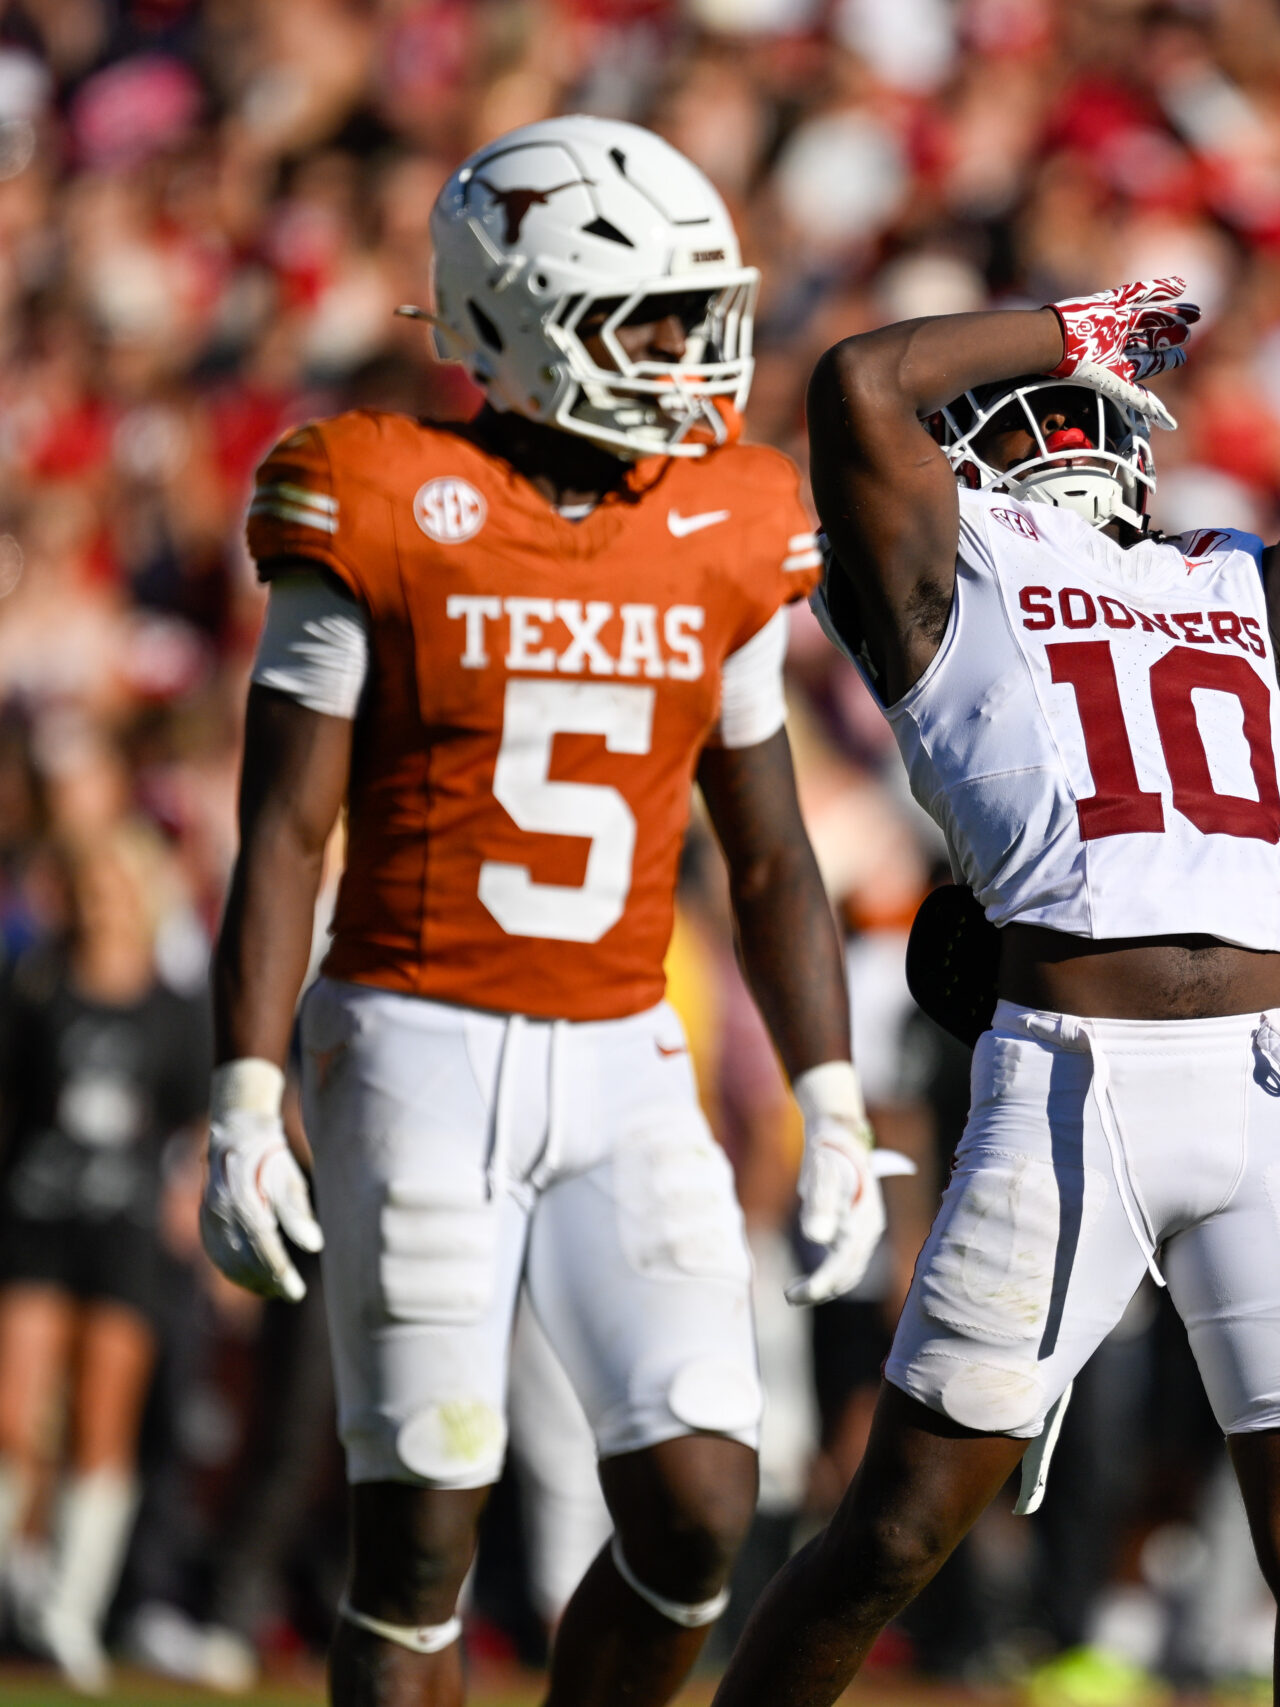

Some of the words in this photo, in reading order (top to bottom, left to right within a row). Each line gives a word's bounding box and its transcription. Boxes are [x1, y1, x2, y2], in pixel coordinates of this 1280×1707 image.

[422, 482, 480, 537] SEC
[446, 594, 704, 681] TEXAS
[1019, 586, 1266, 659] SOONERS
[477, 678, 655, 943] 5
